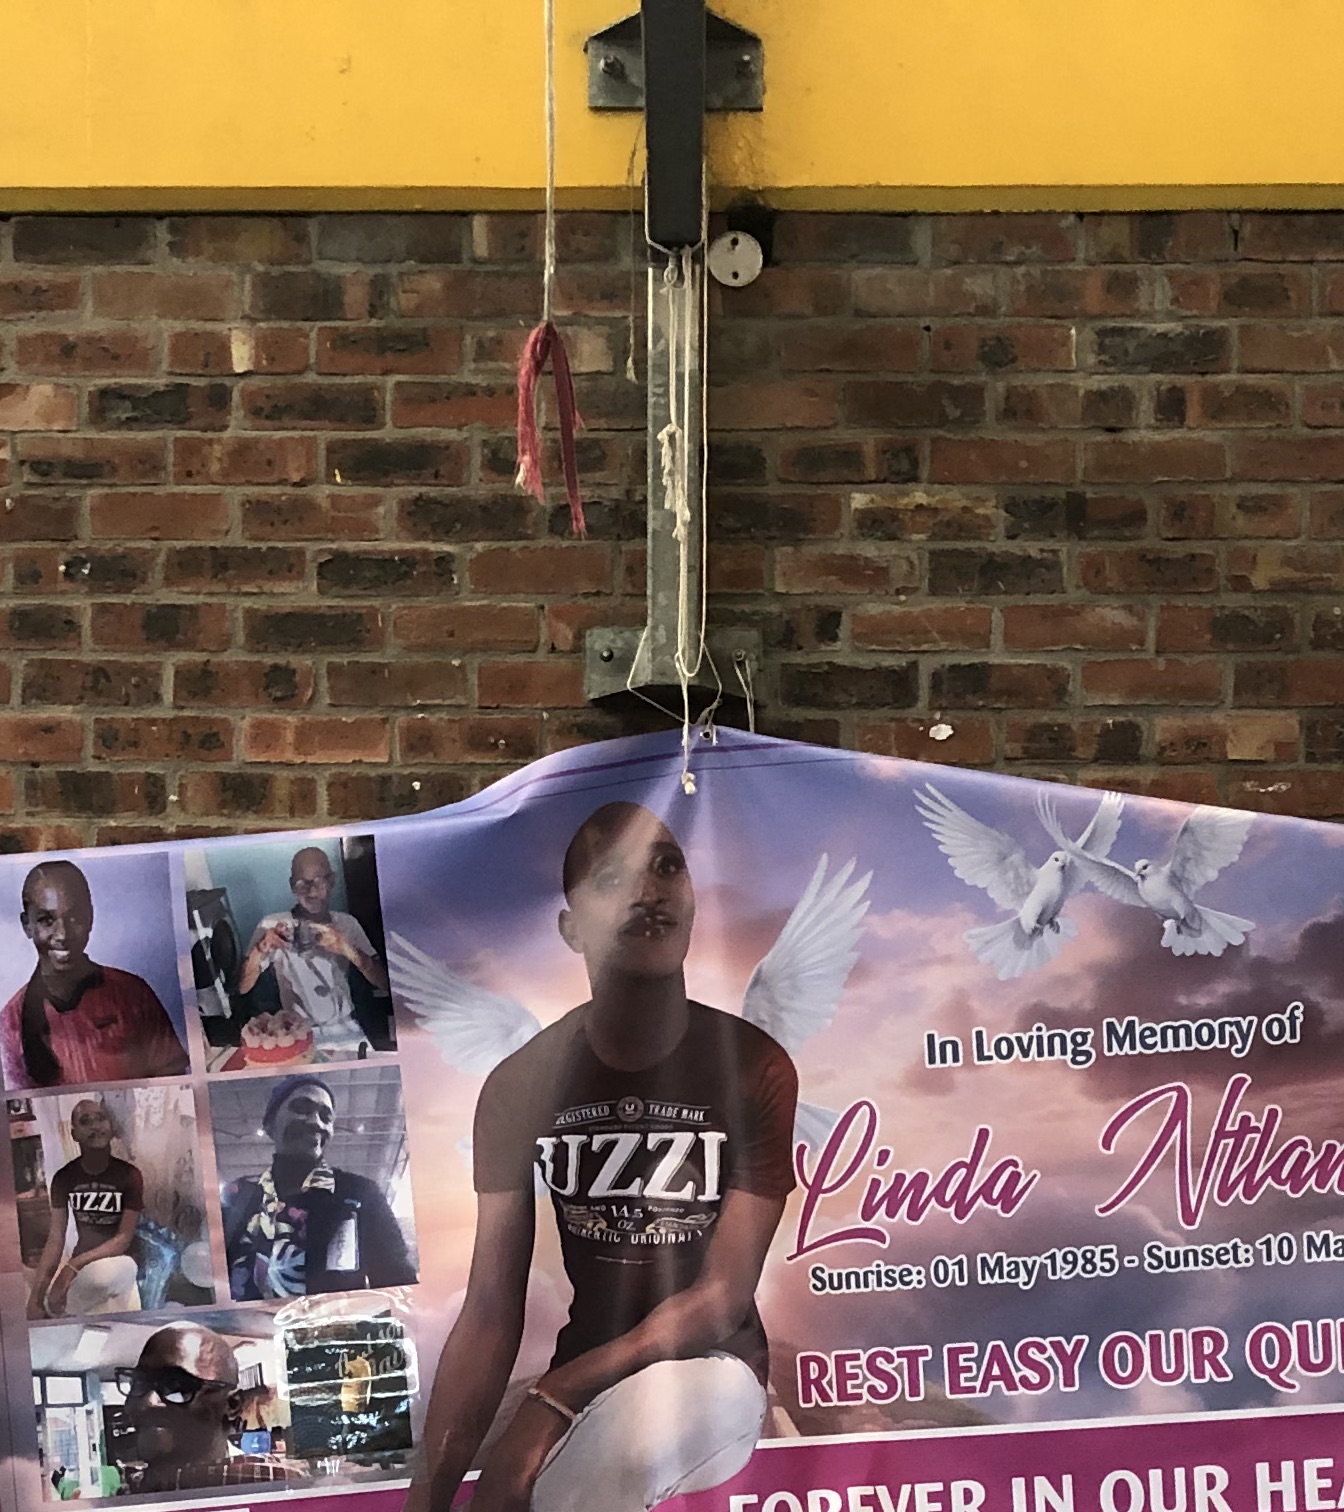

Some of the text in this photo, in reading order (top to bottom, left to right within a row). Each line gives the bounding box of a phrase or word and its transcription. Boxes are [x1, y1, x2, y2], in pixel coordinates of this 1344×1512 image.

[926, 1004, 1303, 1067] In Loving Memory of
[649, 1104, 677, 1118] TRADE
[681, 1108, 705, 1122] MARK
[536, 1131, 727, 1202] UZZI
[787, 1101, 1038, 1261] Linda
[69, 1192, 123, 1212] UZZI
[811, 1264, 925, 1295] Sunrise:
[931, 1260, 969, 1288] 01
[979, 1256, 1038, 1289] May
[1043, 1247, 1116, 1280] 1985
[1147, 1241, 1253, 1271] Sunset:
[1260, 1236, 1294, 1265] 10
[799, 1349, 928, 1407] REST
[945, 1337, 1088, 1397] EASY
[1101, 1328, 1231, 1387] OUR
